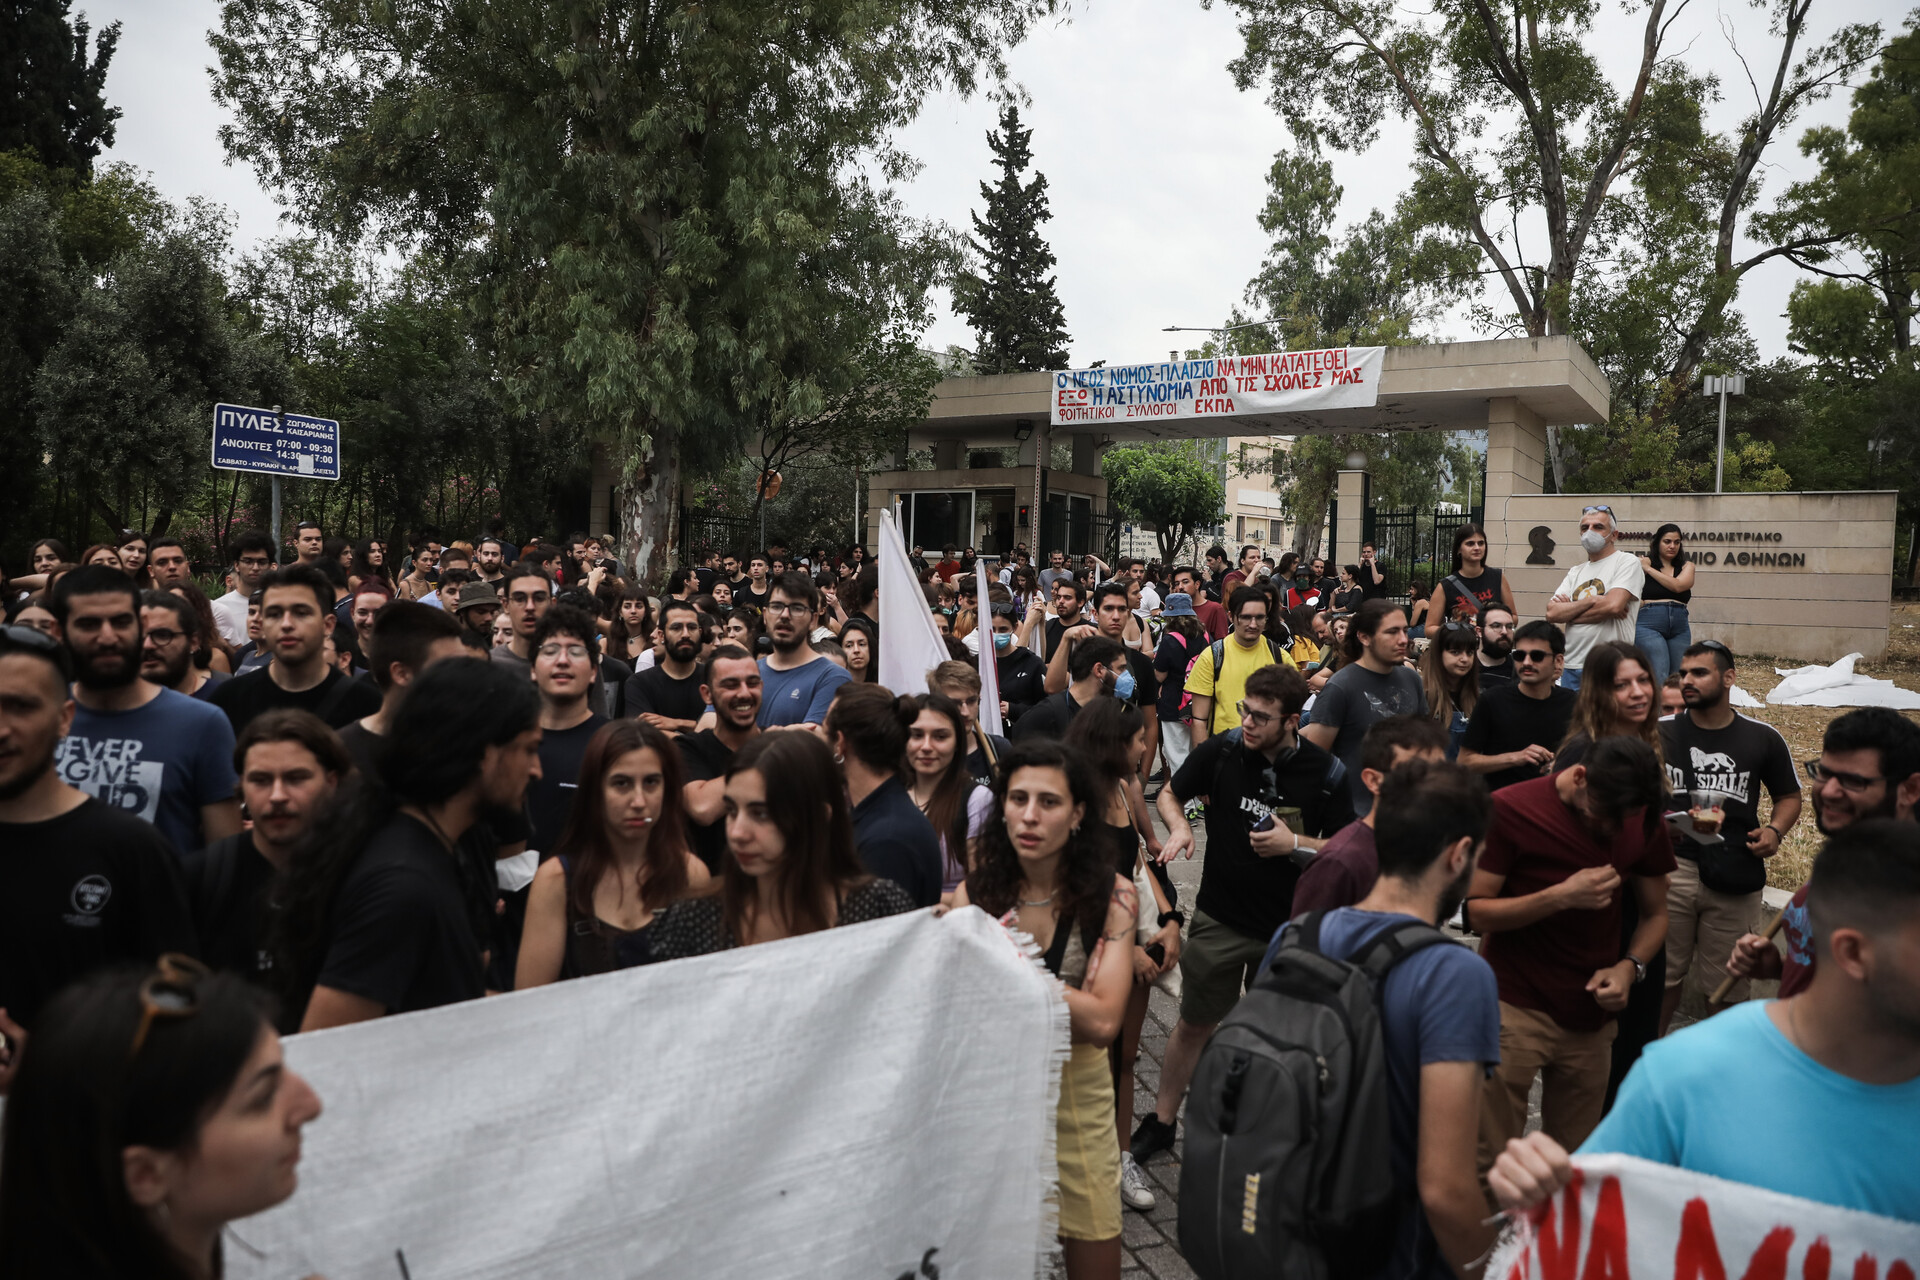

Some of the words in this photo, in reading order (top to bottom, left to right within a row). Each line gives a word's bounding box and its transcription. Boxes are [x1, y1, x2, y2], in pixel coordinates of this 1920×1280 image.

[1057, 372, 1068, 389] Ο
[1073, 369, 1106, 388] ΝΕΟΣ
[1110, 360, 1214, 386] ΝΟΜΟΣ-ΠΛΑΙΣΙΟ
[1217, 359, 1236, 377] ΝΑ
[1241, 355, 1267, 376] ΜΗΝ
[1271, 349, 1348, 375] ΚΑΤΑΤΕΘΕΙ
[1058, 389, 1088, 407] ΕΞΩ
[1093, 388, 1102, 406] Η
[1107, 381, 1194, 405] ΑΣΤΥΝΟΜΙΑ
[1199, 376, 1228, 398] ΑΠΟ
[1235, 376, 1258, 393] ΤΙΣ
[1264, 371, 1323, 391] ΣΧΟΛΕΣ
[1331, 367, 1364, 386] ΜΑΣ
[1058, 406, 1116, 422] ΦΟΙΤΗΤΙΚΟΙ
[1126, 403, 1178, 417] ΣΥΛΛΟΓΟΙ
[1195, 398, 1236, 414] ΕΚΠΑ
[221, 410, 284, 433] ΠΥΛΕΣ
[286, 420, 326, 431] ΖΩΓΡΑΦΟΥ
[286, 428, 335, 440] ΚΑΙΣΑΡΙΑΝΗΣ
[221, 438, 273, 452] ΑΝΟΙΧΤΕΣ
[276, 439, 302, 449] 07:00
[309, 443, 333, 454] 09:30
[276, 450, 301, 460] 14:30
[217, 457, 248, 466] ΣΑΒΒΑΤΟ
[252, 462, 279, 470] ΚΥΡΙΑΚΗ
[1682, 532, 1783, 542] ΚΑΠΟΔΙΣΤΡΙΑΚΟ
[1723, 551, 1806, 567] ΑΘΗΝΩΝ
[65, 760, 141, 784] GIVE
